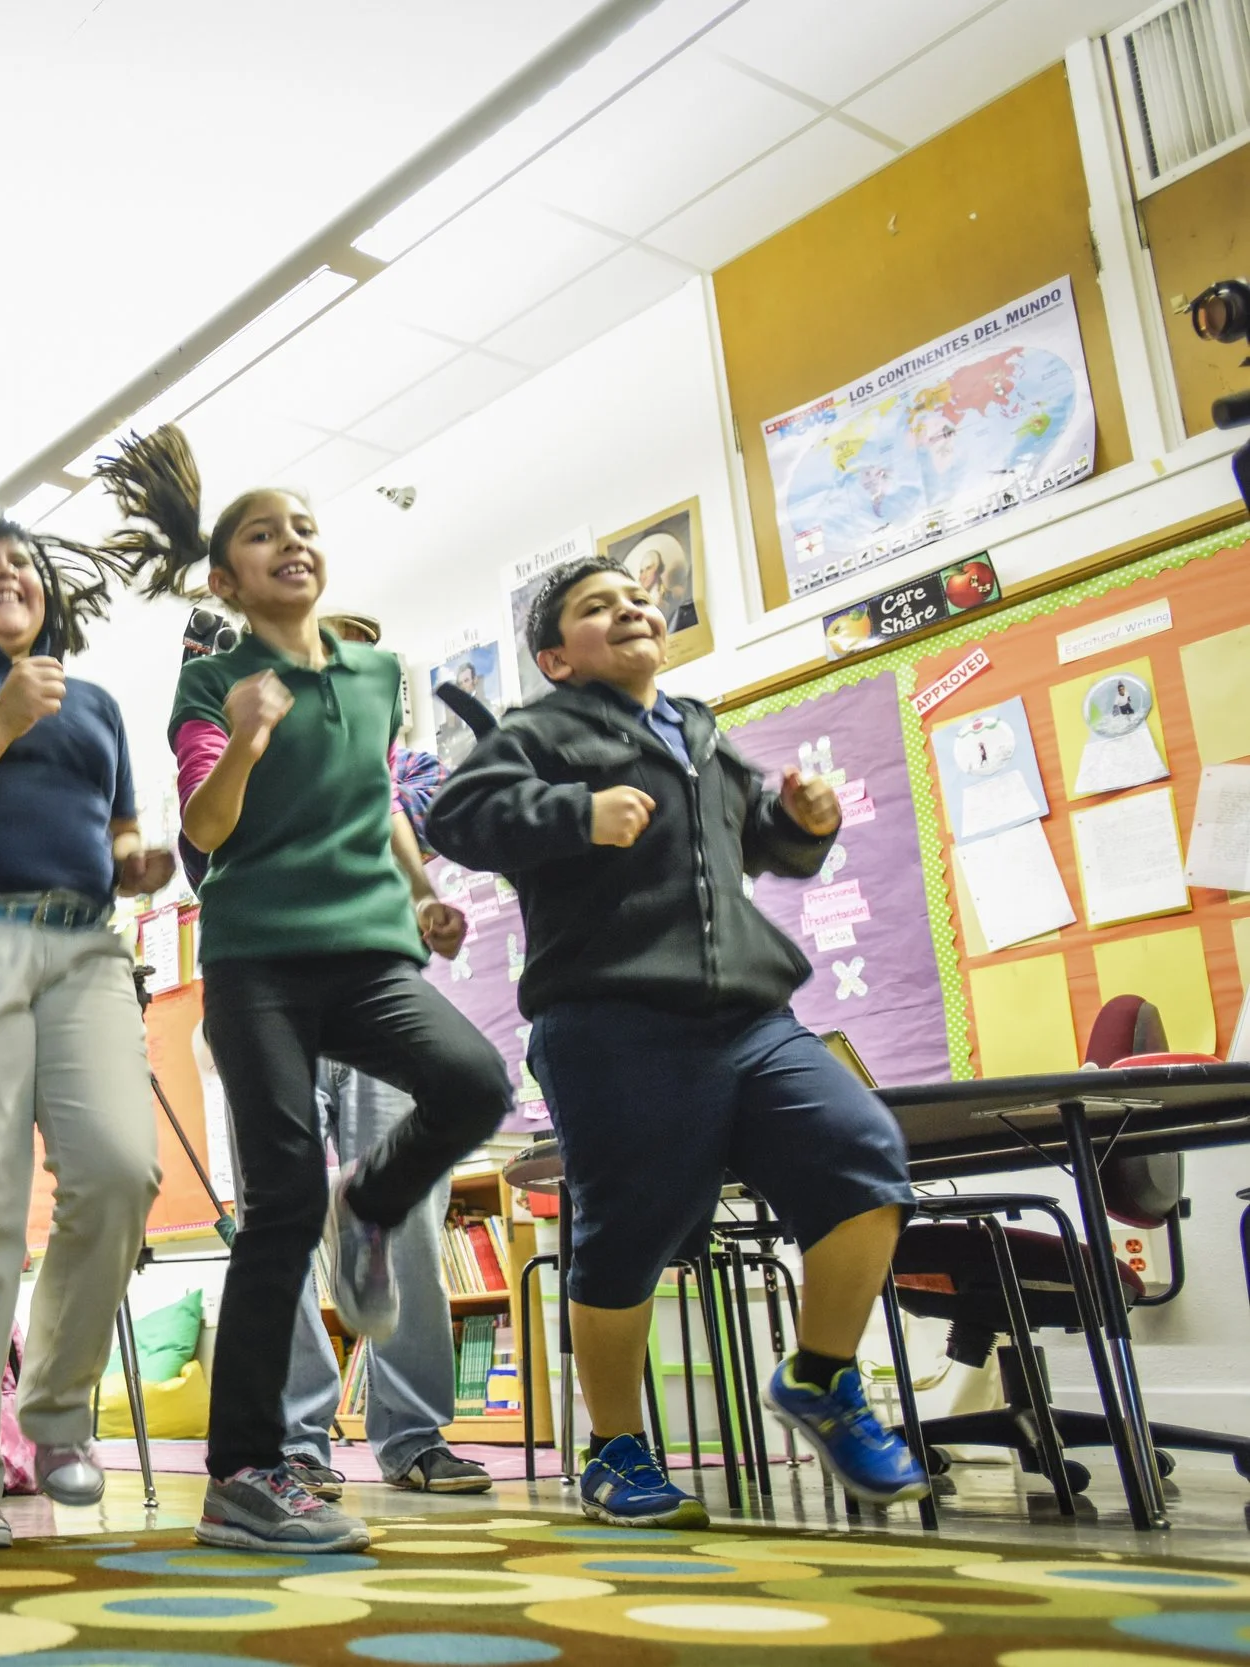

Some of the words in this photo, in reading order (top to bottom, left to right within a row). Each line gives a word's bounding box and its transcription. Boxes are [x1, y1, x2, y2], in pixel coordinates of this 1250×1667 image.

[849, 381, 874, 402] LOS
[877, 334, 970, 388] CONTINENTES
[974, 319, 1002, 340] DEL
[1005, 288, 1062, 325] MUNDO
[881, 587, 927, 614] Care
[901, 603, 913, 618] &
[880, 605, 937, 634] Share
[1124, 612, 1170, 633] Writing
[916, 652, 985, 711] APPROVED
